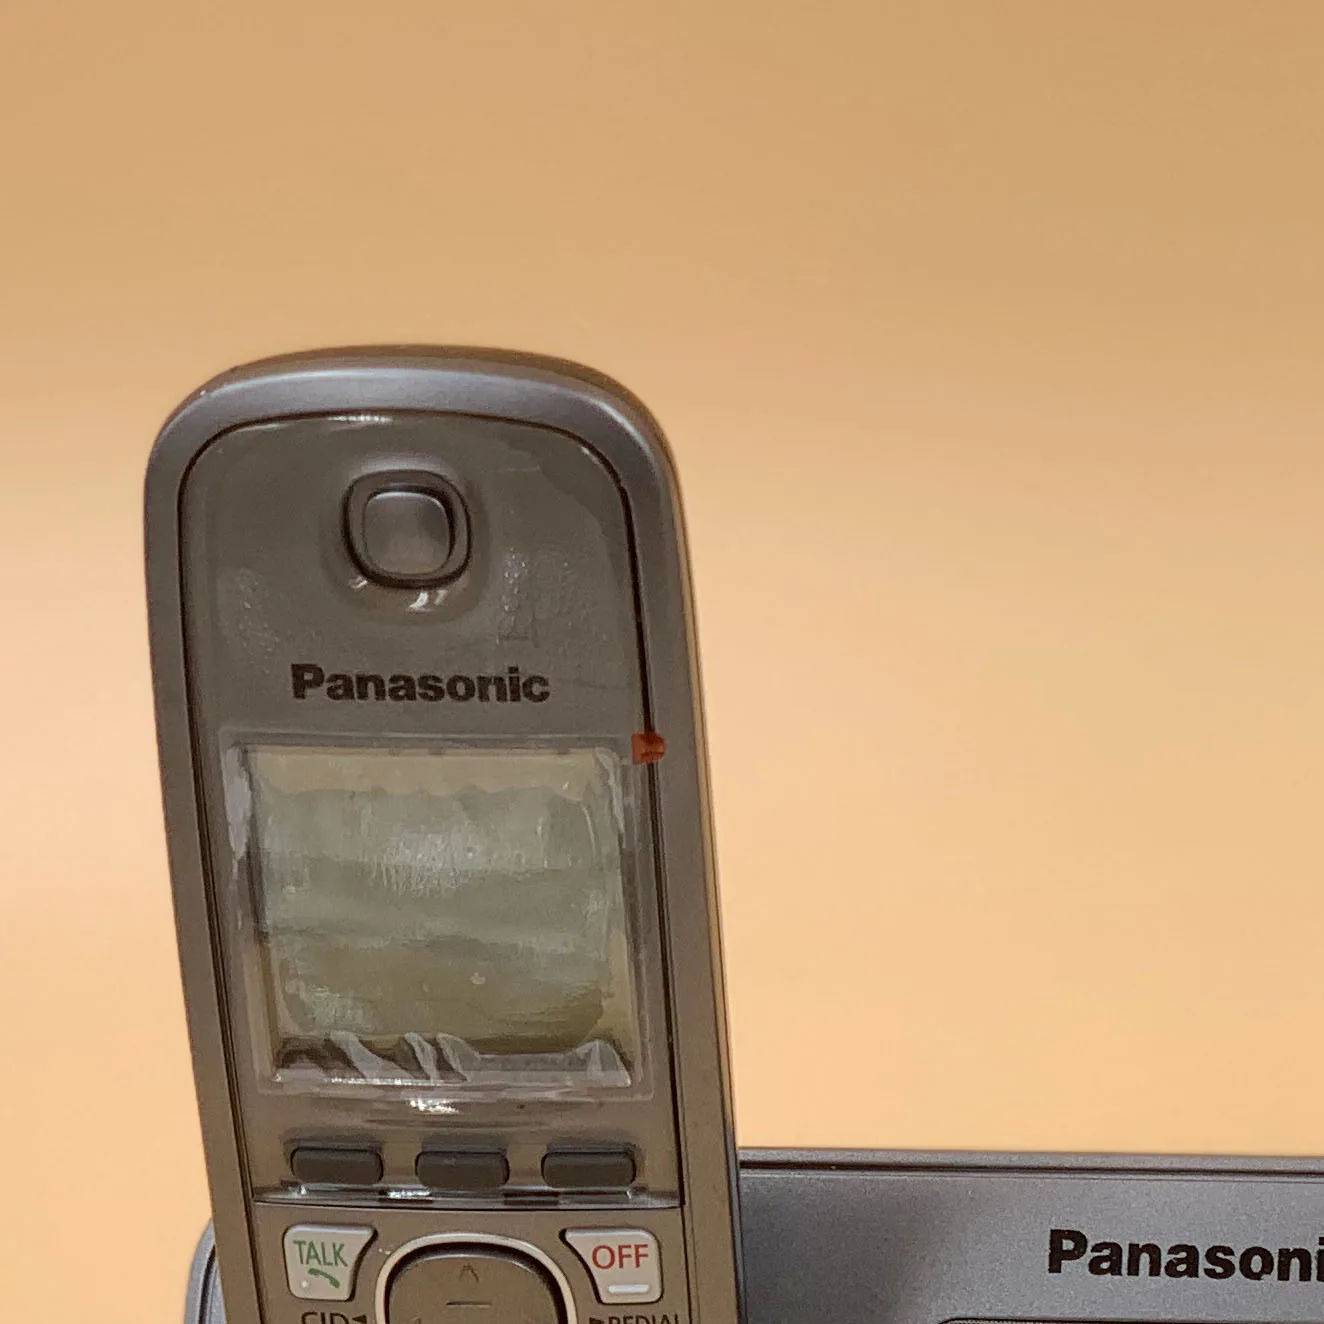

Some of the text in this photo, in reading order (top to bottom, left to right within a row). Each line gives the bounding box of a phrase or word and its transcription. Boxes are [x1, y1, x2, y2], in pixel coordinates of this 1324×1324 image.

[290, 662, 551, 702] Panasonic
[294, 1240, 348, 1267] TALK
[591, 1244, 649, 1270] OFF
